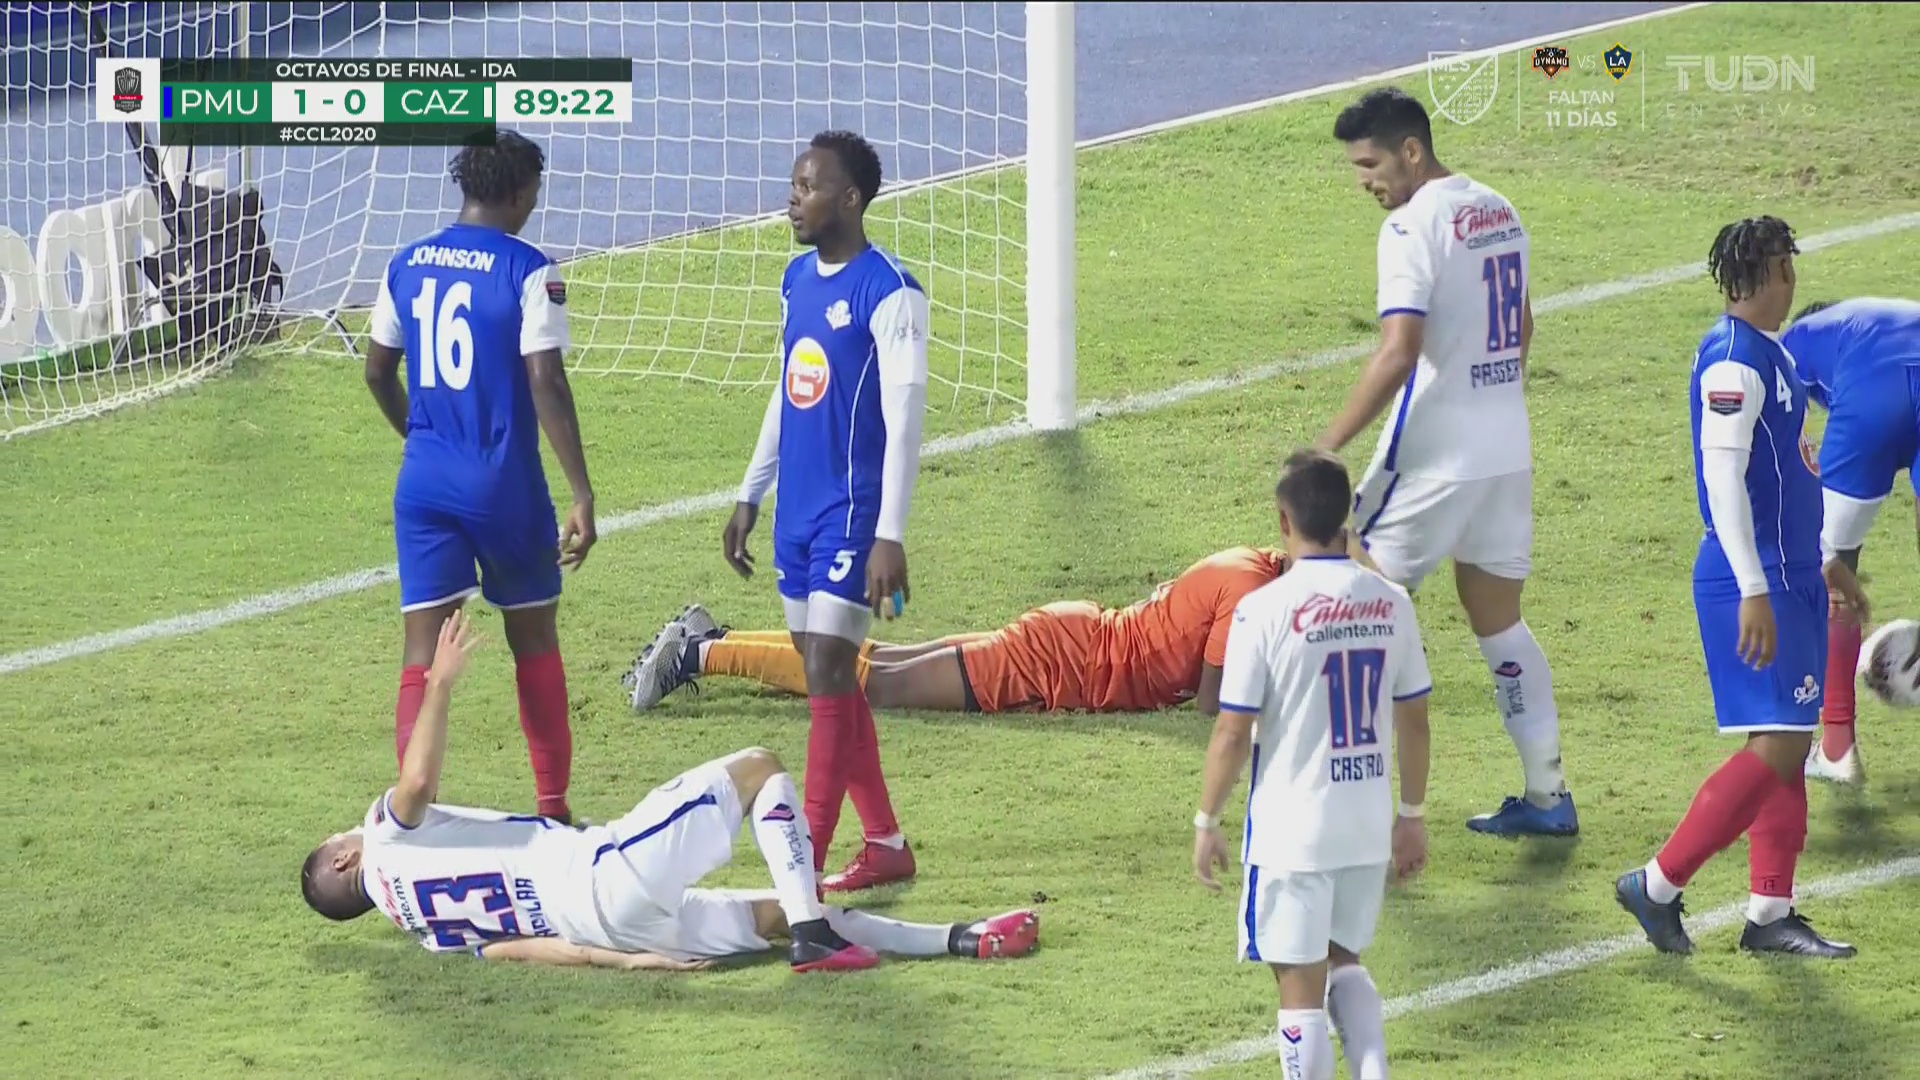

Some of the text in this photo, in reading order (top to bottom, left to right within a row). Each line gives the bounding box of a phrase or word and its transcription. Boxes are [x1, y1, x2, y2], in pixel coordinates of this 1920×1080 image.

[407, 245, 496, 273] JOHNSON
[1482, 250, 1523, 353] 18
[411, 277, 475, 391] 16
[1775, 365, 1792, 413] 4
[828, 550, 858, 582] 5
[1292, 593, 1395, 633] Caliente
[1305, 623, 1395, 644] caliente.mx
[1321, 648, 1387, 750] 10
[412, 872, 521, 948] 23
